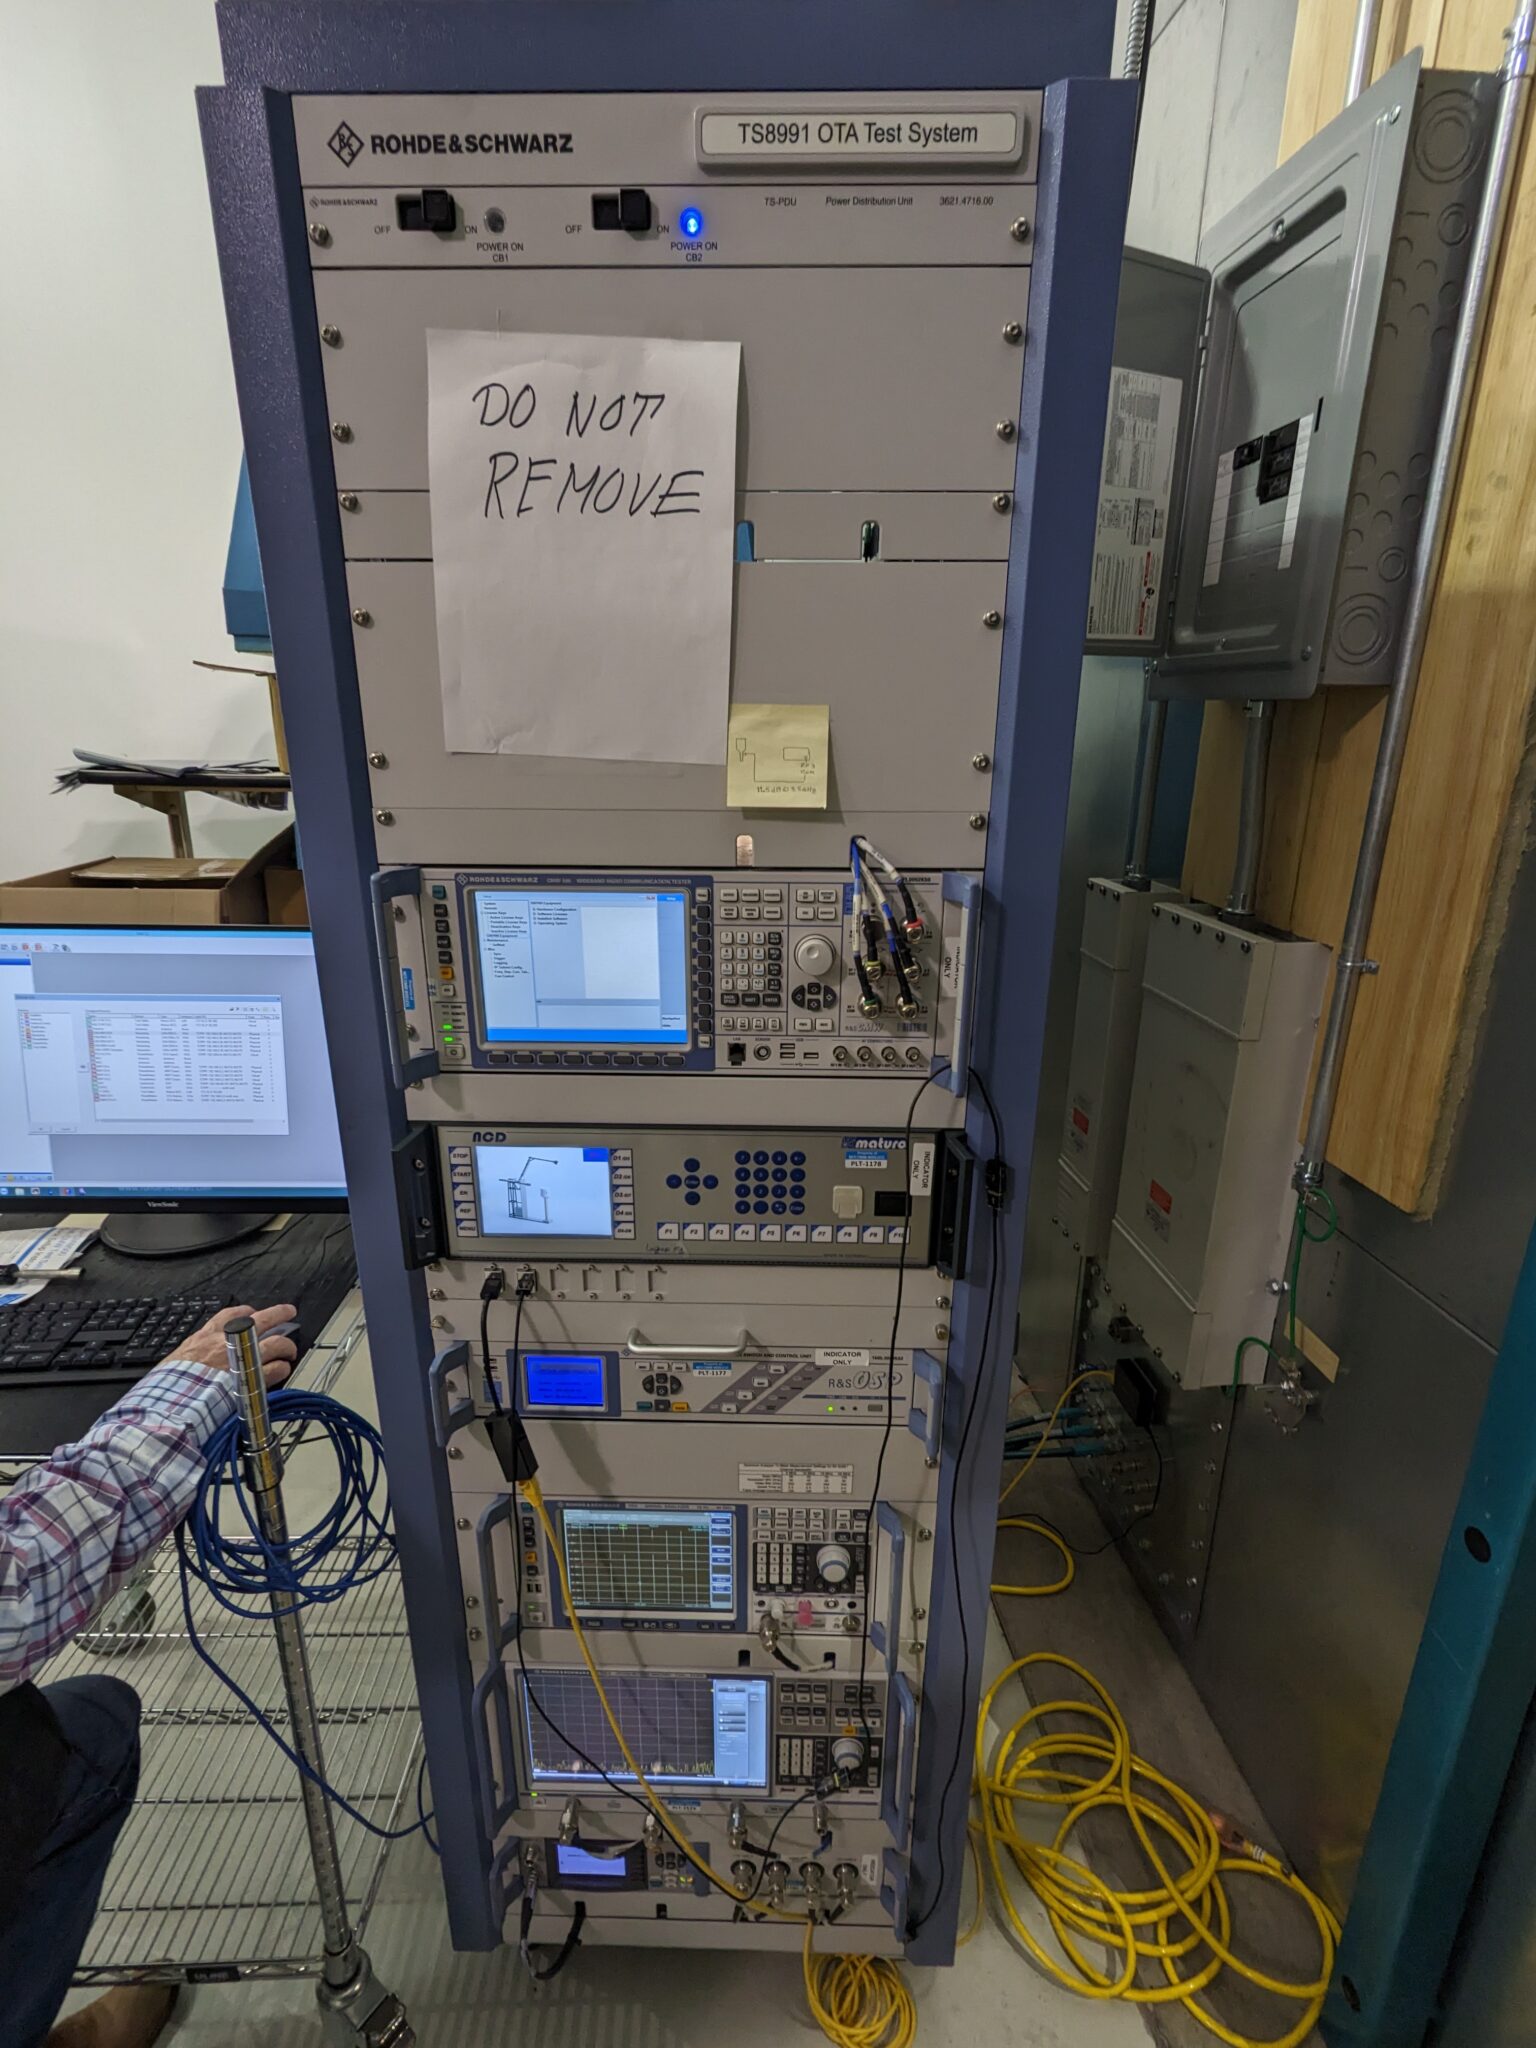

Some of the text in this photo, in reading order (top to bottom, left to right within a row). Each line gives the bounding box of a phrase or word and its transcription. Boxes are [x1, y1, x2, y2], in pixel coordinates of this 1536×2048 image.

[738, 120, 979, 148] TS8991 OTA Test System
[370, 133, 574, 155] ROHDE&SCHWARZ
[764, 196, 798, 208] TS-PDU
[825, 196, 851, 207] Power
[852, 196, 897, 207] Distribution
[374, 225, 392, 236] OFF
[464, 224, 479, 235] ON
[565, 224, 583, 235] OFF
[656, 224, 670, 235] ON
[476, 241, 524, 252] POWER ON
[670, 240, 718, 252] POWER ON
[492, 253, 509, 264] CB1
[685, 252, 702, 263] CB2
[472, 382, 666, 437] DO NOT
[484, 451, 704, 519] REMOVE
[944, 956, 952, 979] ONLY
[855, 1137, 907, 1149] maturo
[912, 1160, 920, 1179] ONLY
[921, 1151, 931, 1189] INDICATOR
[828, 1378, 852, 1389] R&S
